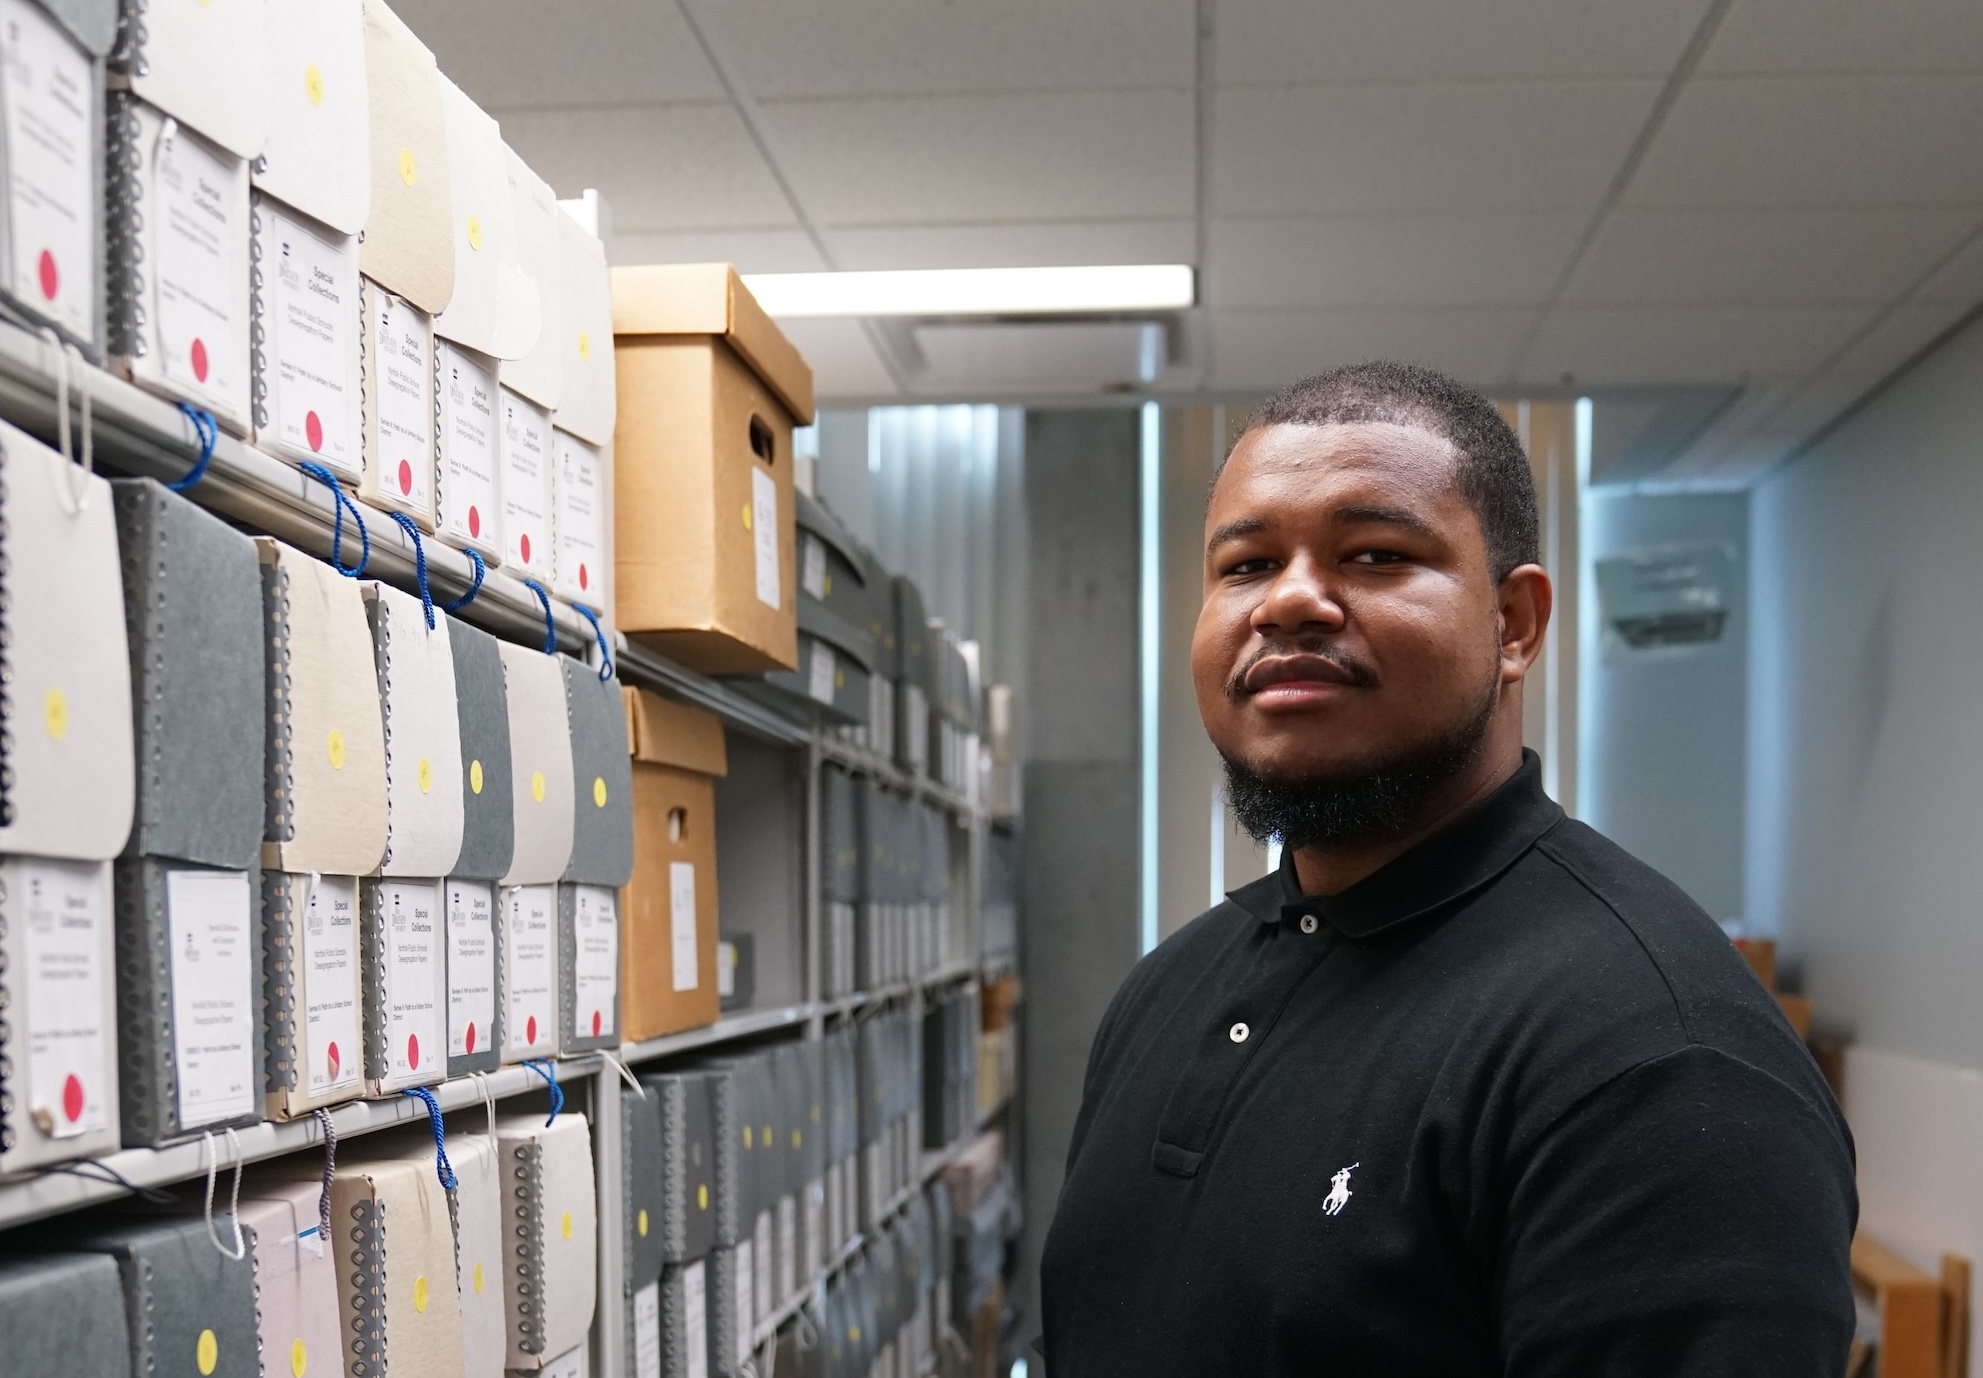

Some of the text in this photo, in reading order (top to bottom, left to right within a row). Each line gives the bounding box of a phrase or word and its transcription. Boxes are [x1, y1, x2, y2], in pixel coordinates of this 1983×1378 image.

[314, 265, 334, 285] Special
[309, 279, 340, 304] Collections
[406, 334, 418, 350] Special
[402, 346, 422, 366] Collections
[475, 386, 486, 401] Special
[472, 397, 490, 416] Collections
[335, 900, 348, 912] Special
[474, 899, 485, 909] Special
[415, 909, 428, 919] Special
[471, 912, 488, 920] Collections
[331, 916, 351, 926] Collections
[411, 923, 431, 932] Collections
[398, 955, 427, 964] Desegregation Papers
